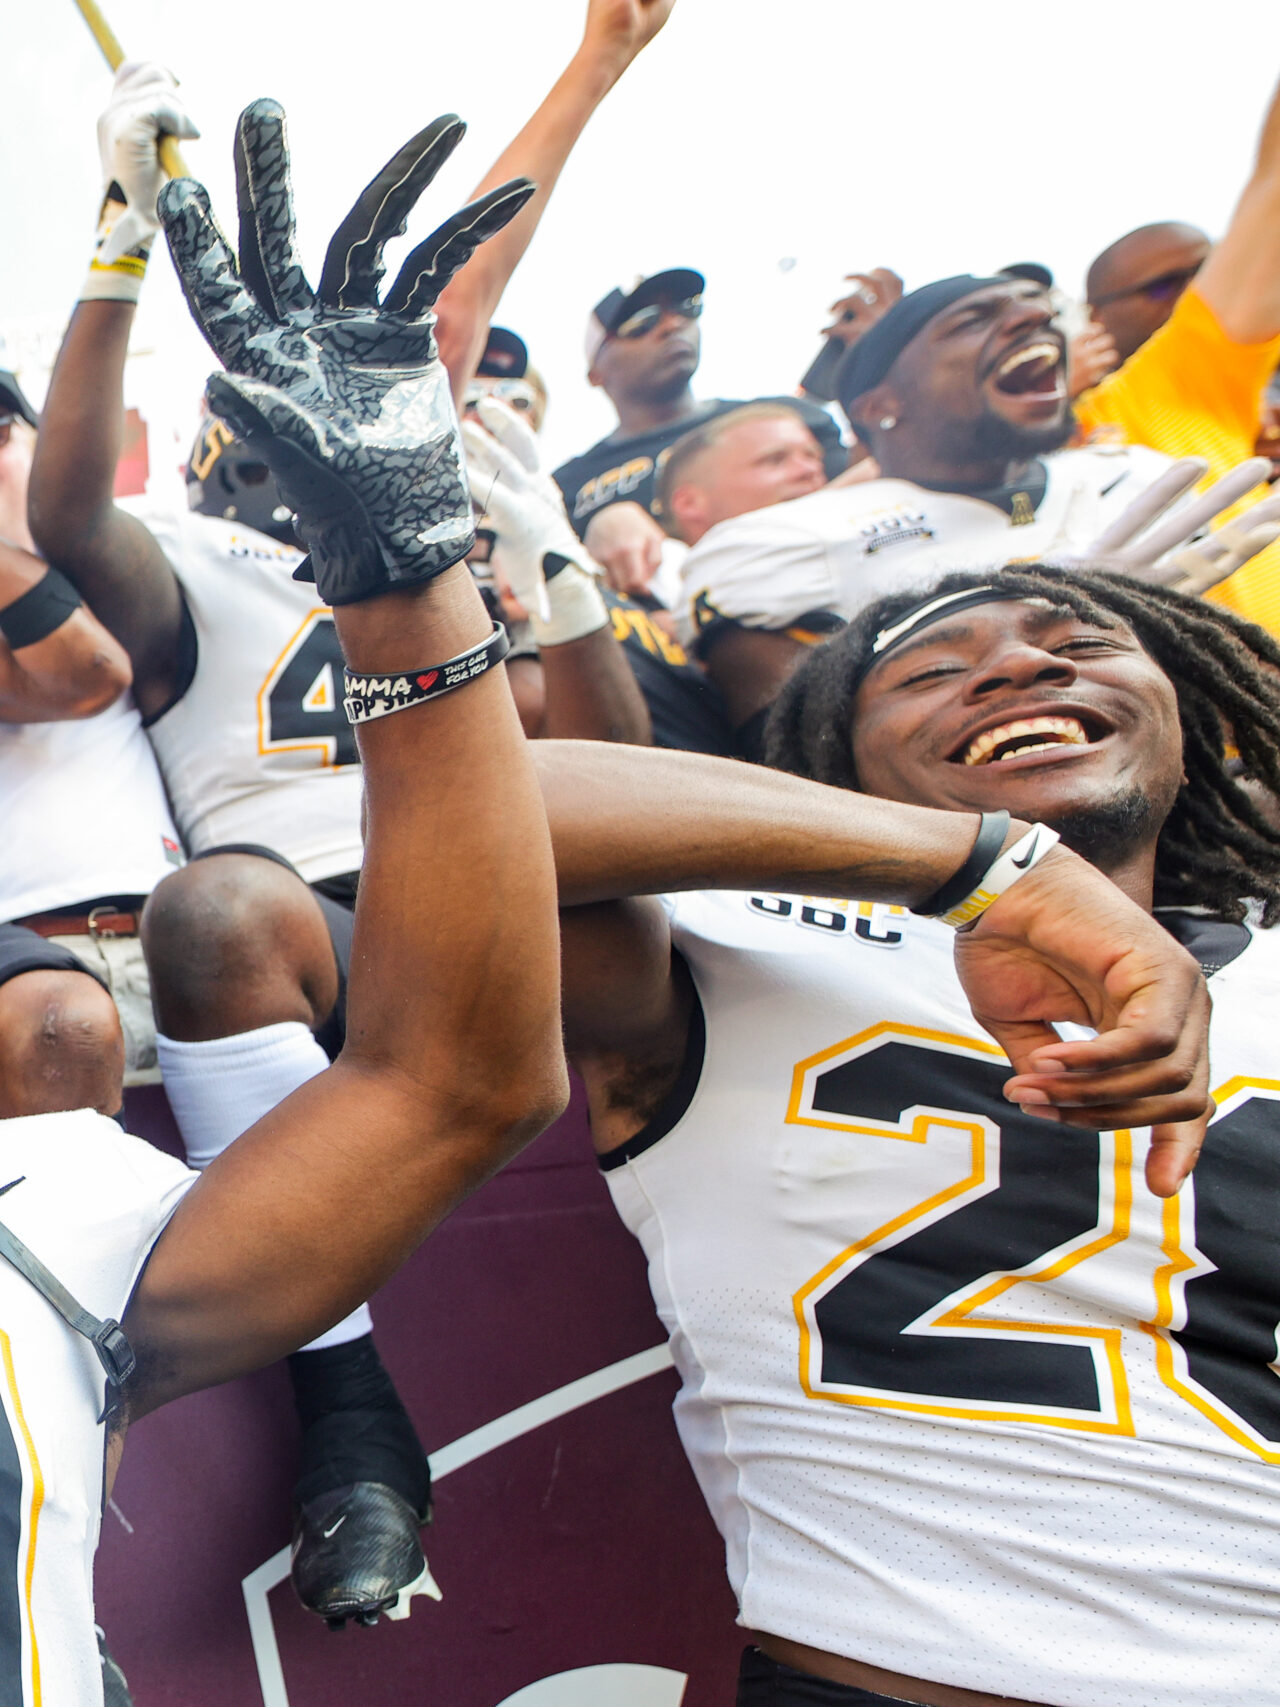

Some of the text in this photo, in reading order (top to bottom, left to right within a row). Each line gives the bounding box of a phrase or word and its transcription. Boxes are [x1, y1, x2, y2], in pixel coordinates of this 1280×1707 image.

[444, 661, 468, 675] THIS
[446, 660, 489, 685] FOR YOU
